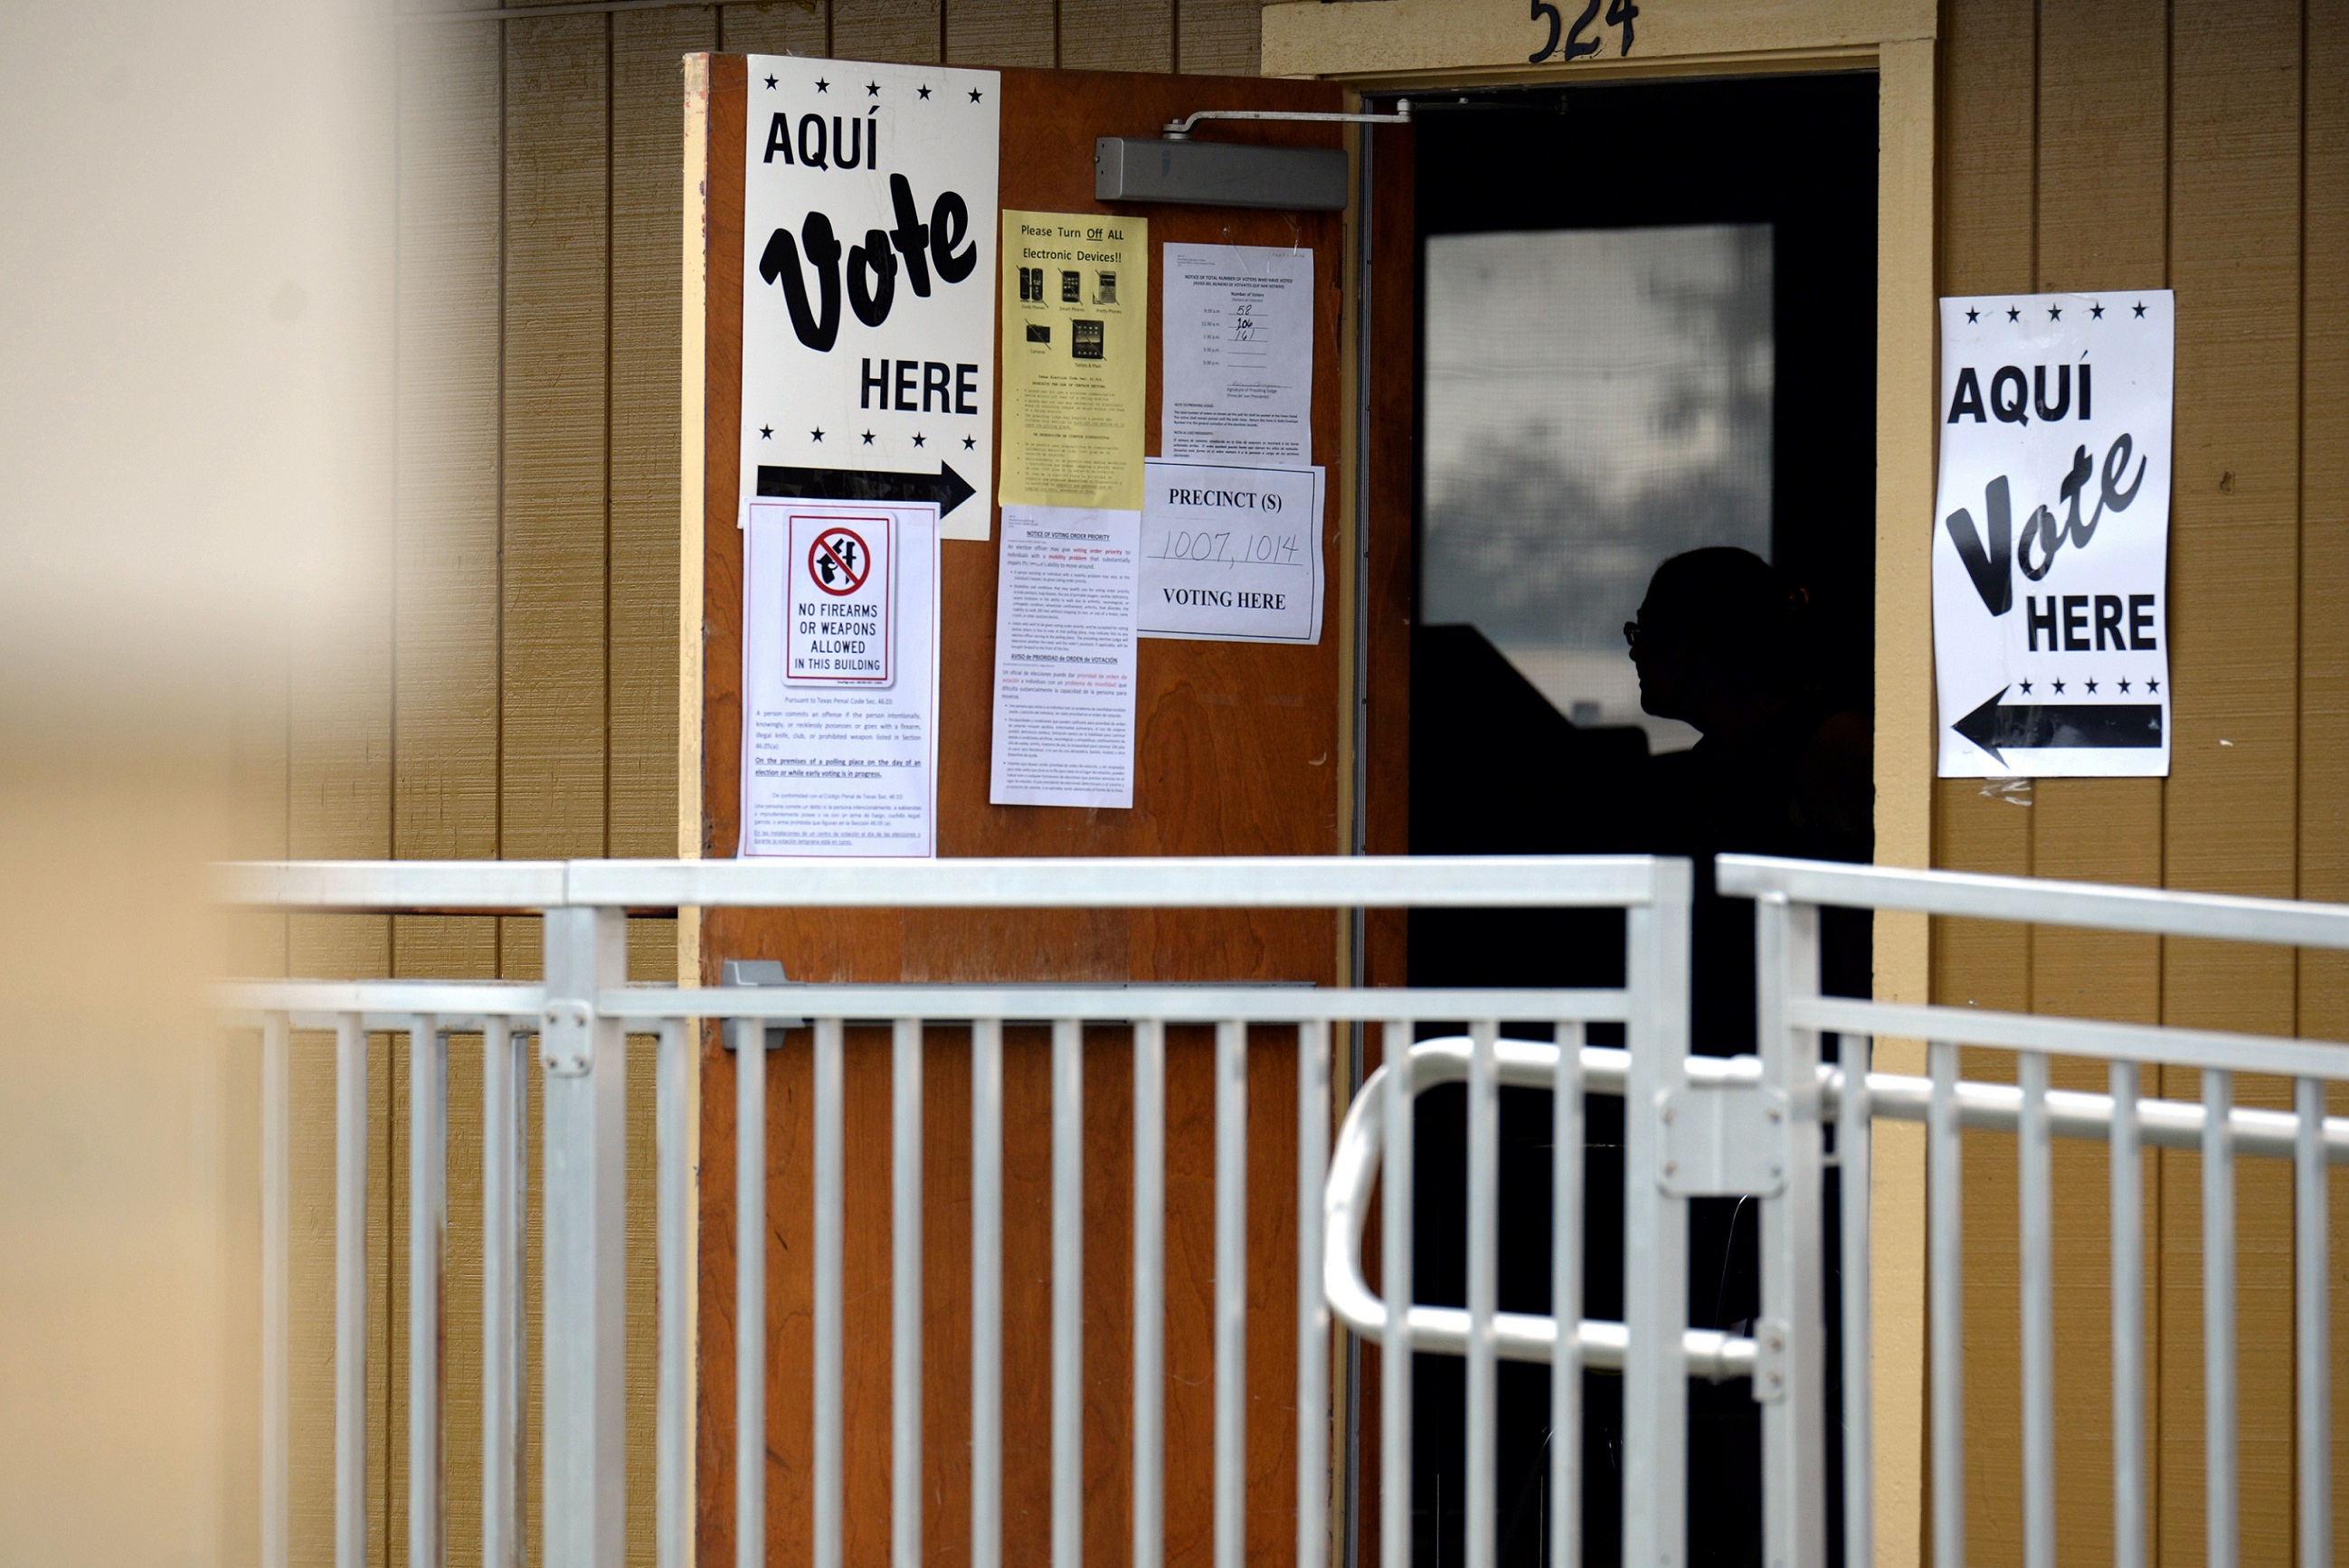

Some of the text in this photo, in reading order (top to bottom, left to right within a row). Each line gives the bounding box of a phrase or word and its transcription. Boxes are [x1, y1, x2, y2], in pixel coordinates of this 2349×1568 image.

[1529, 0, 1639, 63] 524
[762, 105, 880, 172] AQUÍ
[1021, 225, 1124, 241] Please Turn Off ALL
[759, 174, 977, 353] Vote
[1023, 249, 1122, 262] Electronic Devices!!
[860, 358, 979, 415] HERE
[1946, 350, 2092, 427] AQUÍ
[1170, 488, 1282, 514] PRECINCT (S)
[1946, 432, 2147, 617] Vote
[1245, 534, 1300, 563] 1014
[799, 603, 877, 618] NO FIREARMS
[1164, 589, 1285, 609] VOTING HERE
[800, 621, 876, 636] OR WEAPONS
[2026, 594, 2157, 652] HERE
[811, 640, 866, 654] ALLOWED
[795, 658, 880, 670] IN THIS BUILDING
